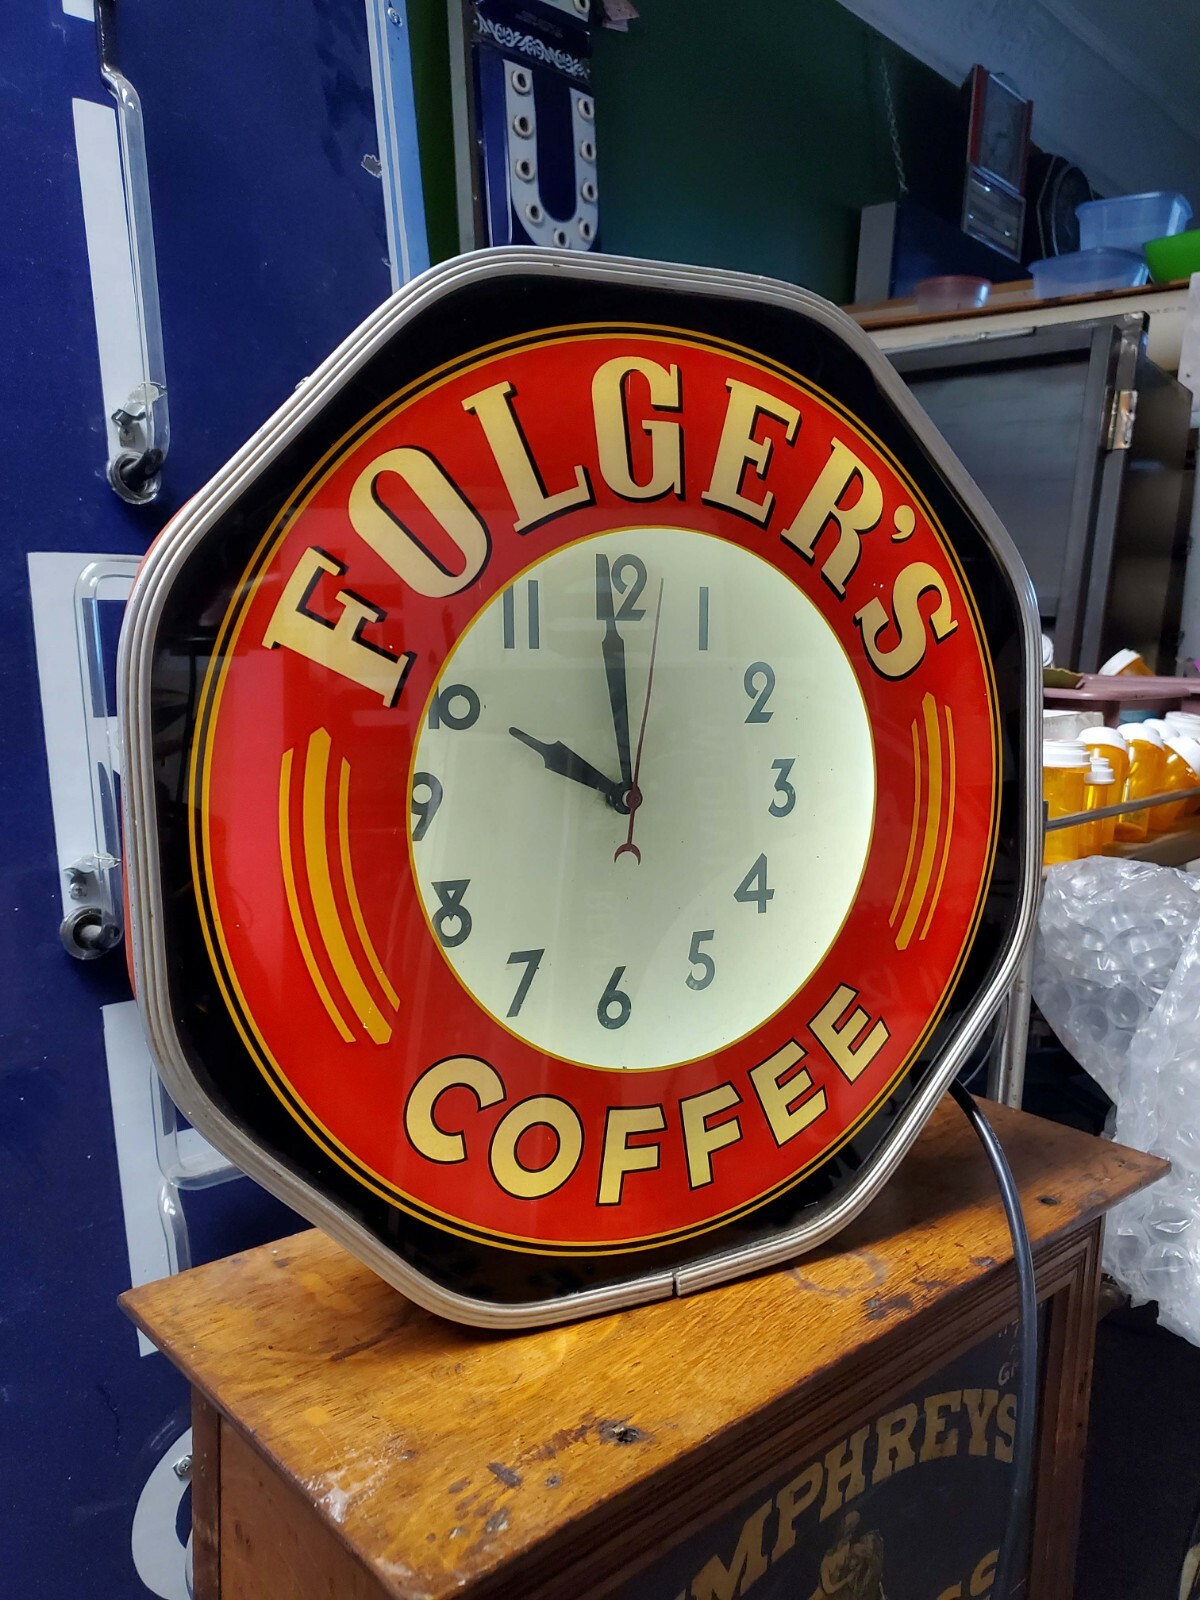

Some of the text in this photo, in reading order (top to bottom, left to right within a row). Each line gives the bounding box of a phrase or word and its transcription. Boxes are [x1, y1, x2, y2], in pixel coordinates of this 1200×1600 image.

[262, 356, 958, 709] FOLGER'S
[502, 579, 540, 650] 11
[595, 553, 648, 621] 12
[698, 586, 709, 651] 1
[427, 683, 481, 731] 10
[743, 661, 777, 724] 2
[409, 771, 444, 842] 9
[767, 758, 797, 818] 3
[430, 879, 473, 948] 8
[732, 852, 776, 914] 4
[505, 948, 546, 1018] 7
[684, 929, 716, 991] 5
[596, 966, 632, 1030] 6
[403, 982, 891, 1207] COFFEE
[674, 1388, 1018, 1600] MPHREYS
